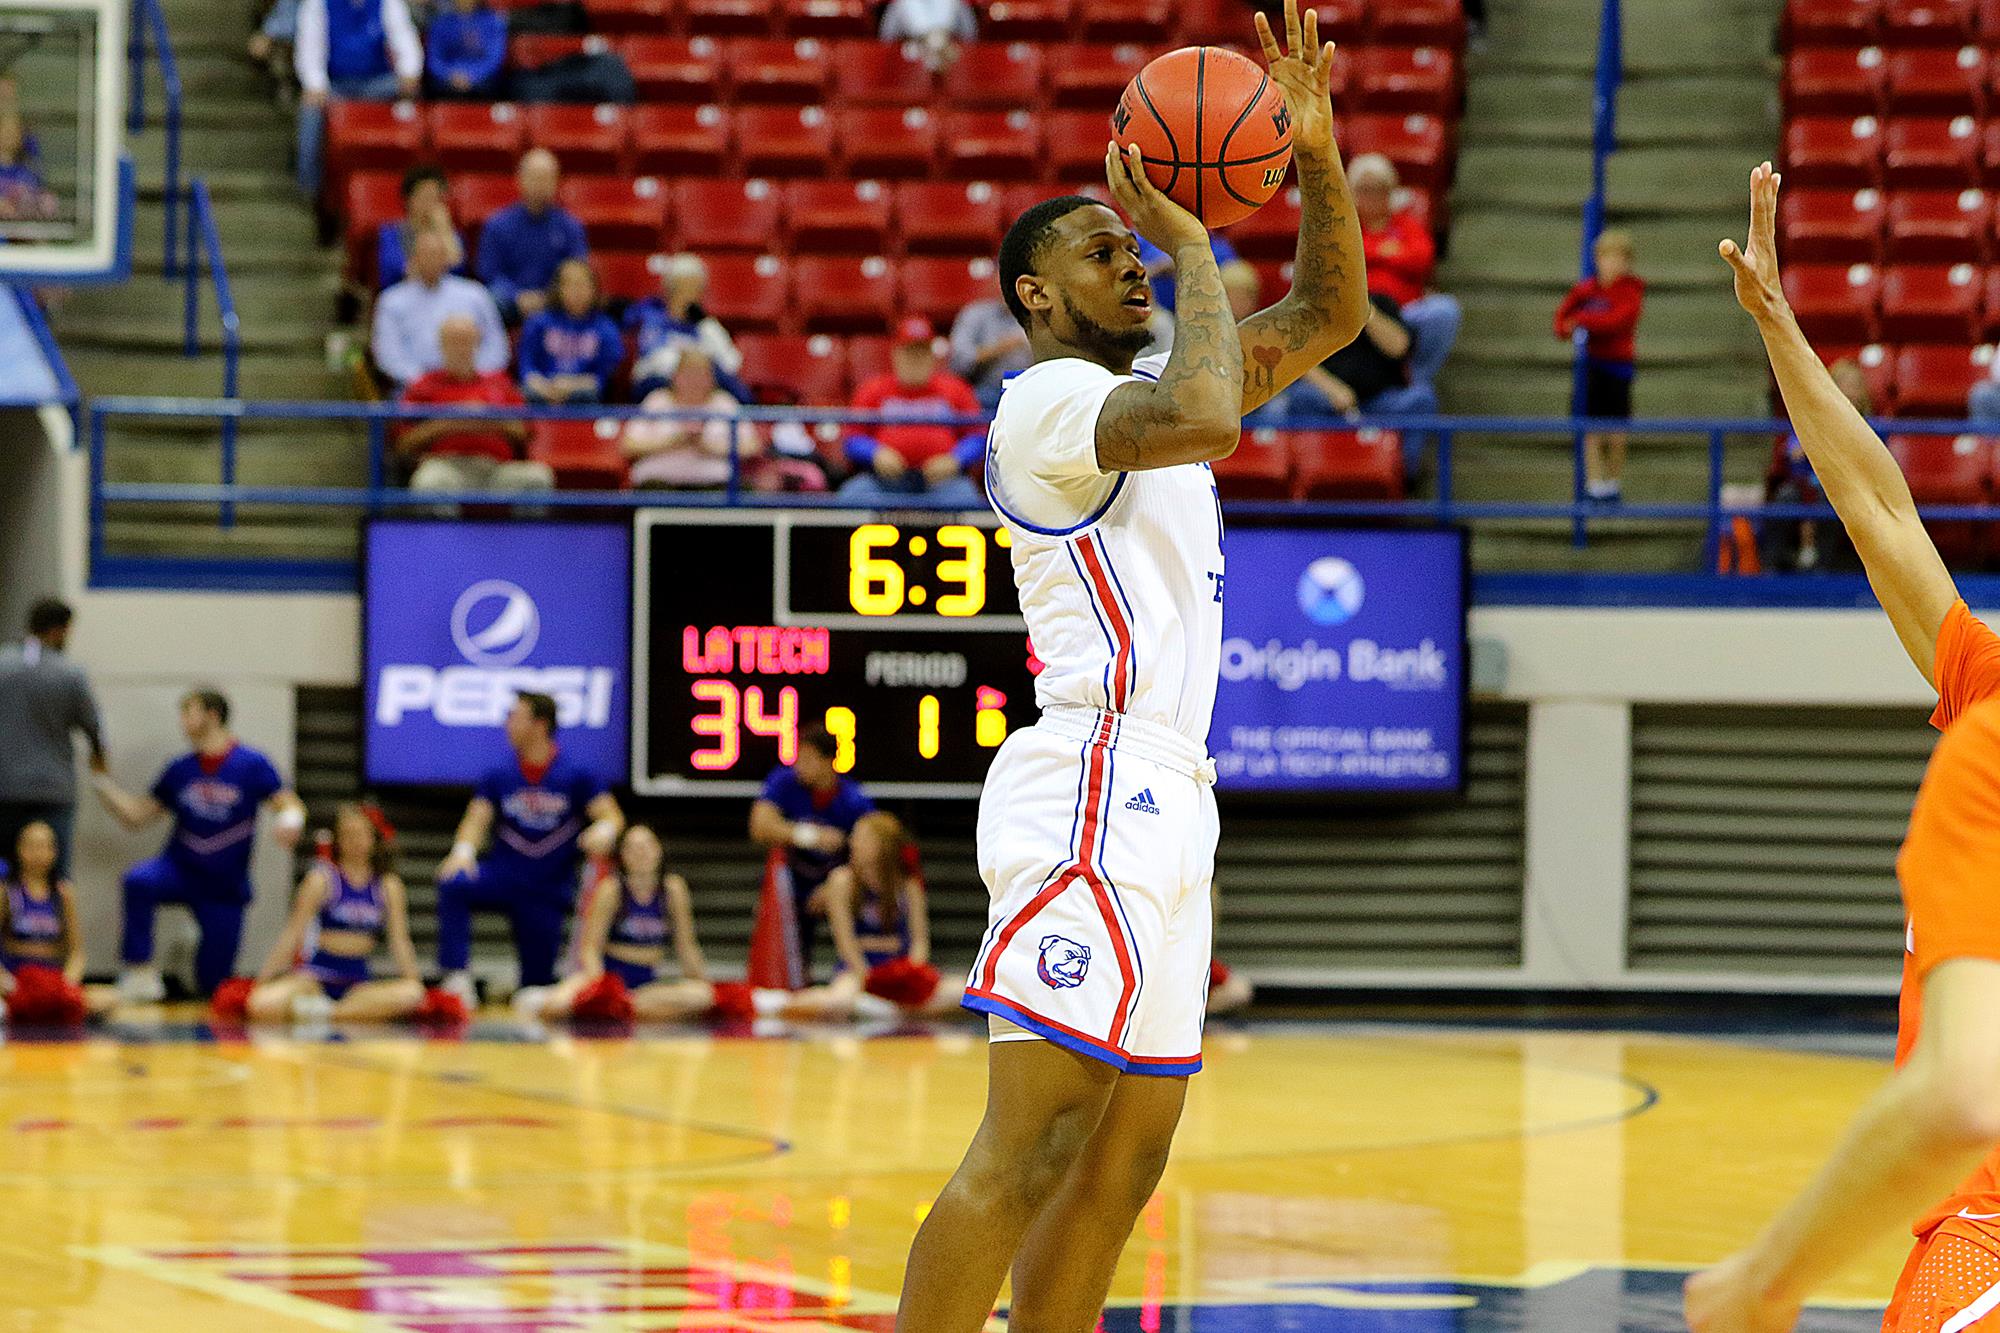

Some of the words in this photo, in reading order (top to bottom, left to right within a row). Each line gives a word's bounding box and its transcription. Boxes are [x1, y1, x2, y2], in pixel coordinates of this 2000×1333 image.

[849, 524, 1013, 617] 6:3
[865, 651, 968, 688] PERIOD
[1220, 637, 1342, 692] Origin
[1348, 637, 1446, 683] Bank
[691, 679, 799, 771] 34
[1124, 801, 1160, 816] adidas
